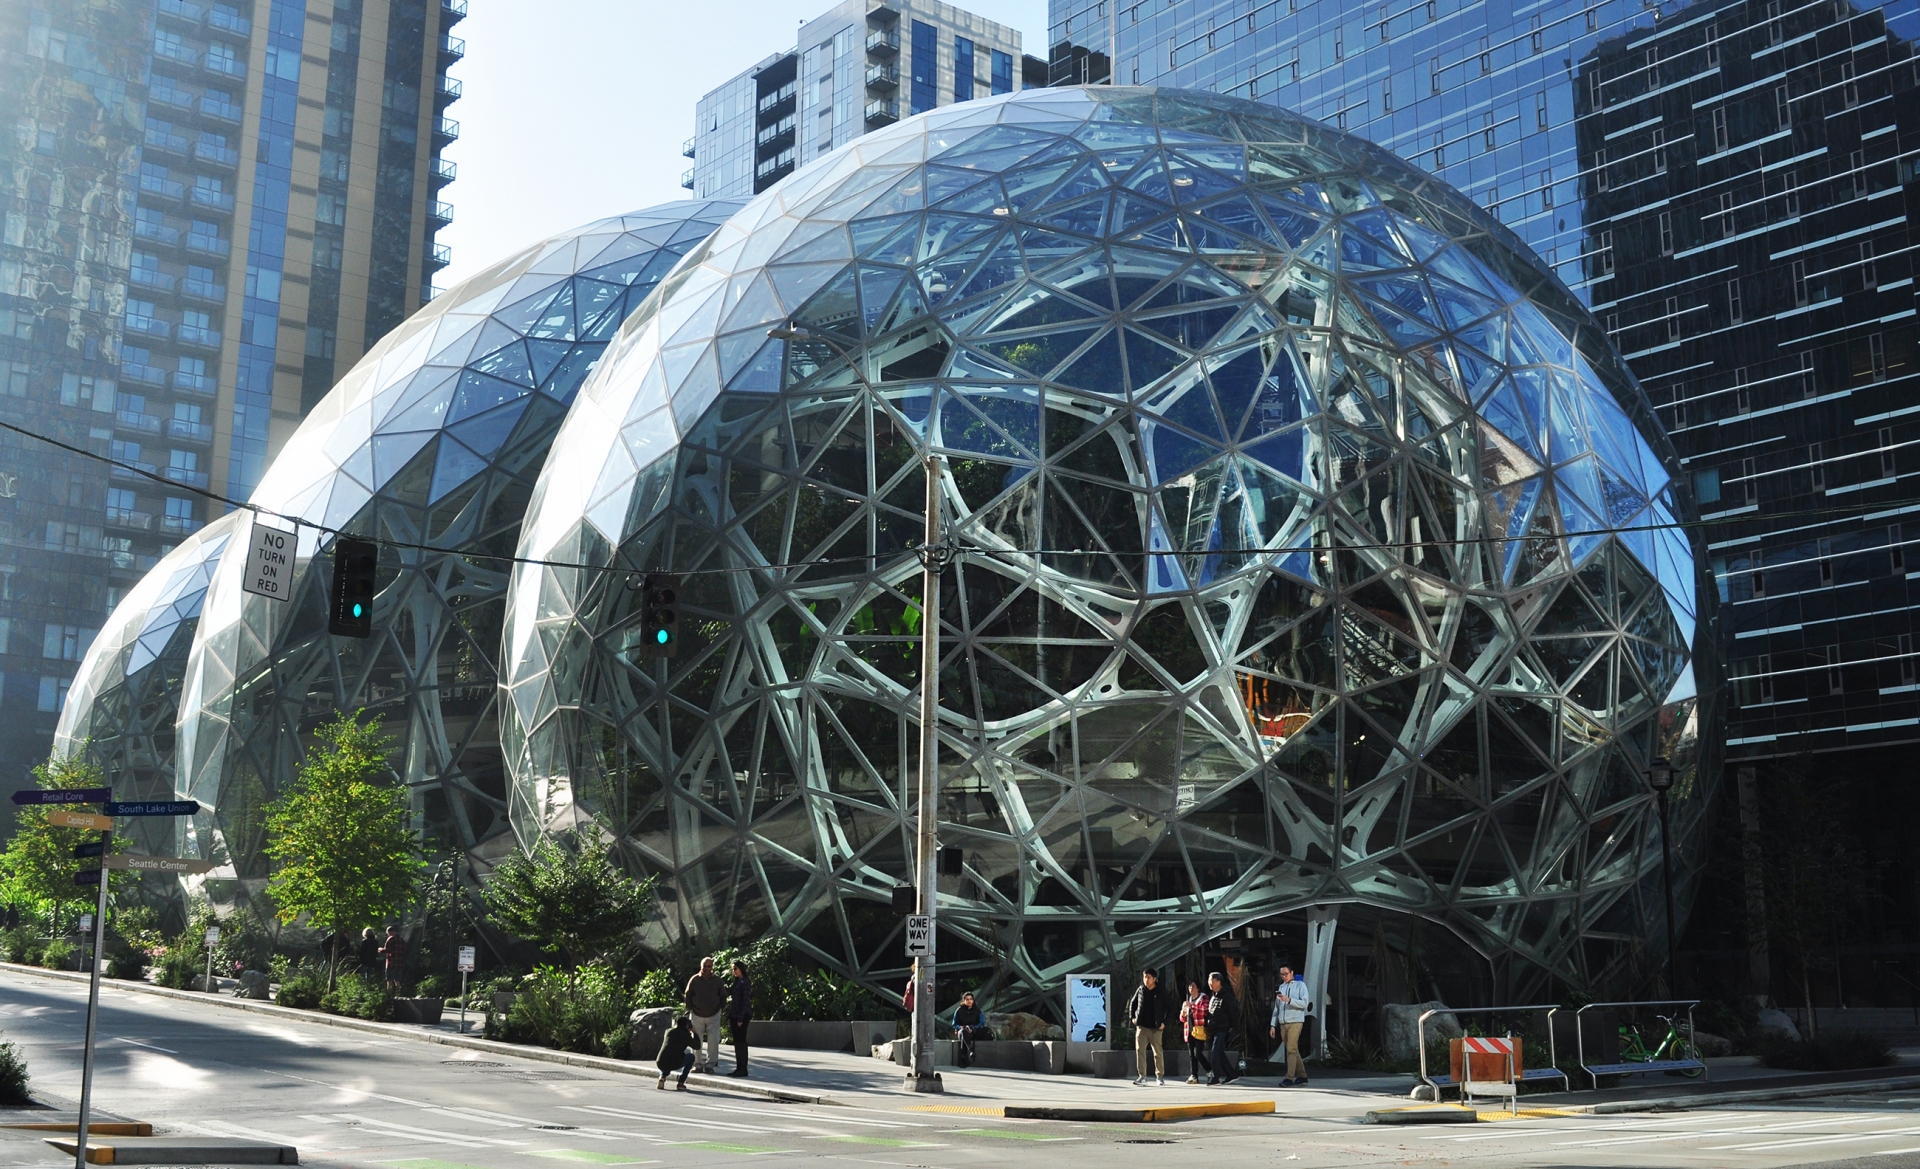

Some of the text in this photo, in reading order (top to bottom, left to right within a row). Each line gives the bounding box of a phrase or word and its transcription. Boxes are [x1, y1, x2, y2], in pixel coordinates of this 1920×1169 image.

[264, 533, 285, 549] NO
[259, 548, 286, 565] TURN
[262, 565, 278, 578] ON
[257, 579, 278, 593] RED
[42, 792, 84, 801] Retail Core
[118, 803, 190, 813] South Lake Union
[66, 815, 95, 826] Capitol Hill
[128, 858, 188, 870] Seattle Center
[909, 918, 928, 928] ONE
[909, 930, 928, 940] WAY
